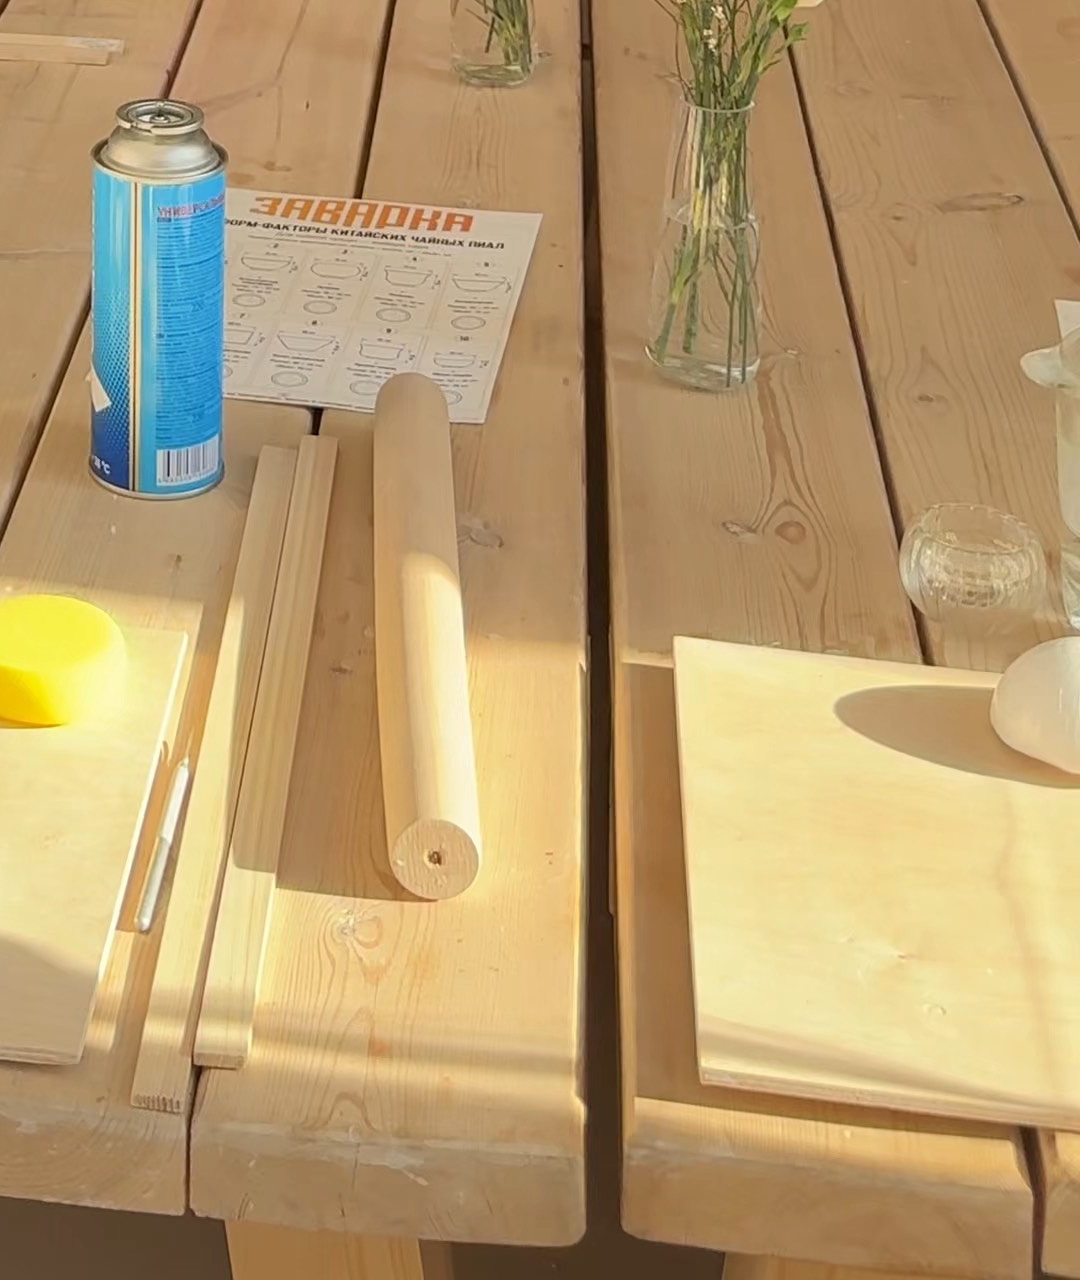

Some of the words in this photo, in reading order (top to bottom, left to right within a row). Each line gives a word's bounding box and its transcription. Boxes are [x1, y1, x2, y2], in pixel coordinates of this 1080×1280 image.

[249, 197, 474, 232] ЗАВАРКА
[225, 218, 327, 235] ОРМ-ФАКТОРЫ
[330, 228, 407, 242] КИТАЙСКИХ
[411, 235, 465, 248] ЧАЙНЫХ
[468, 241, 505, 250] ПИАЛ
